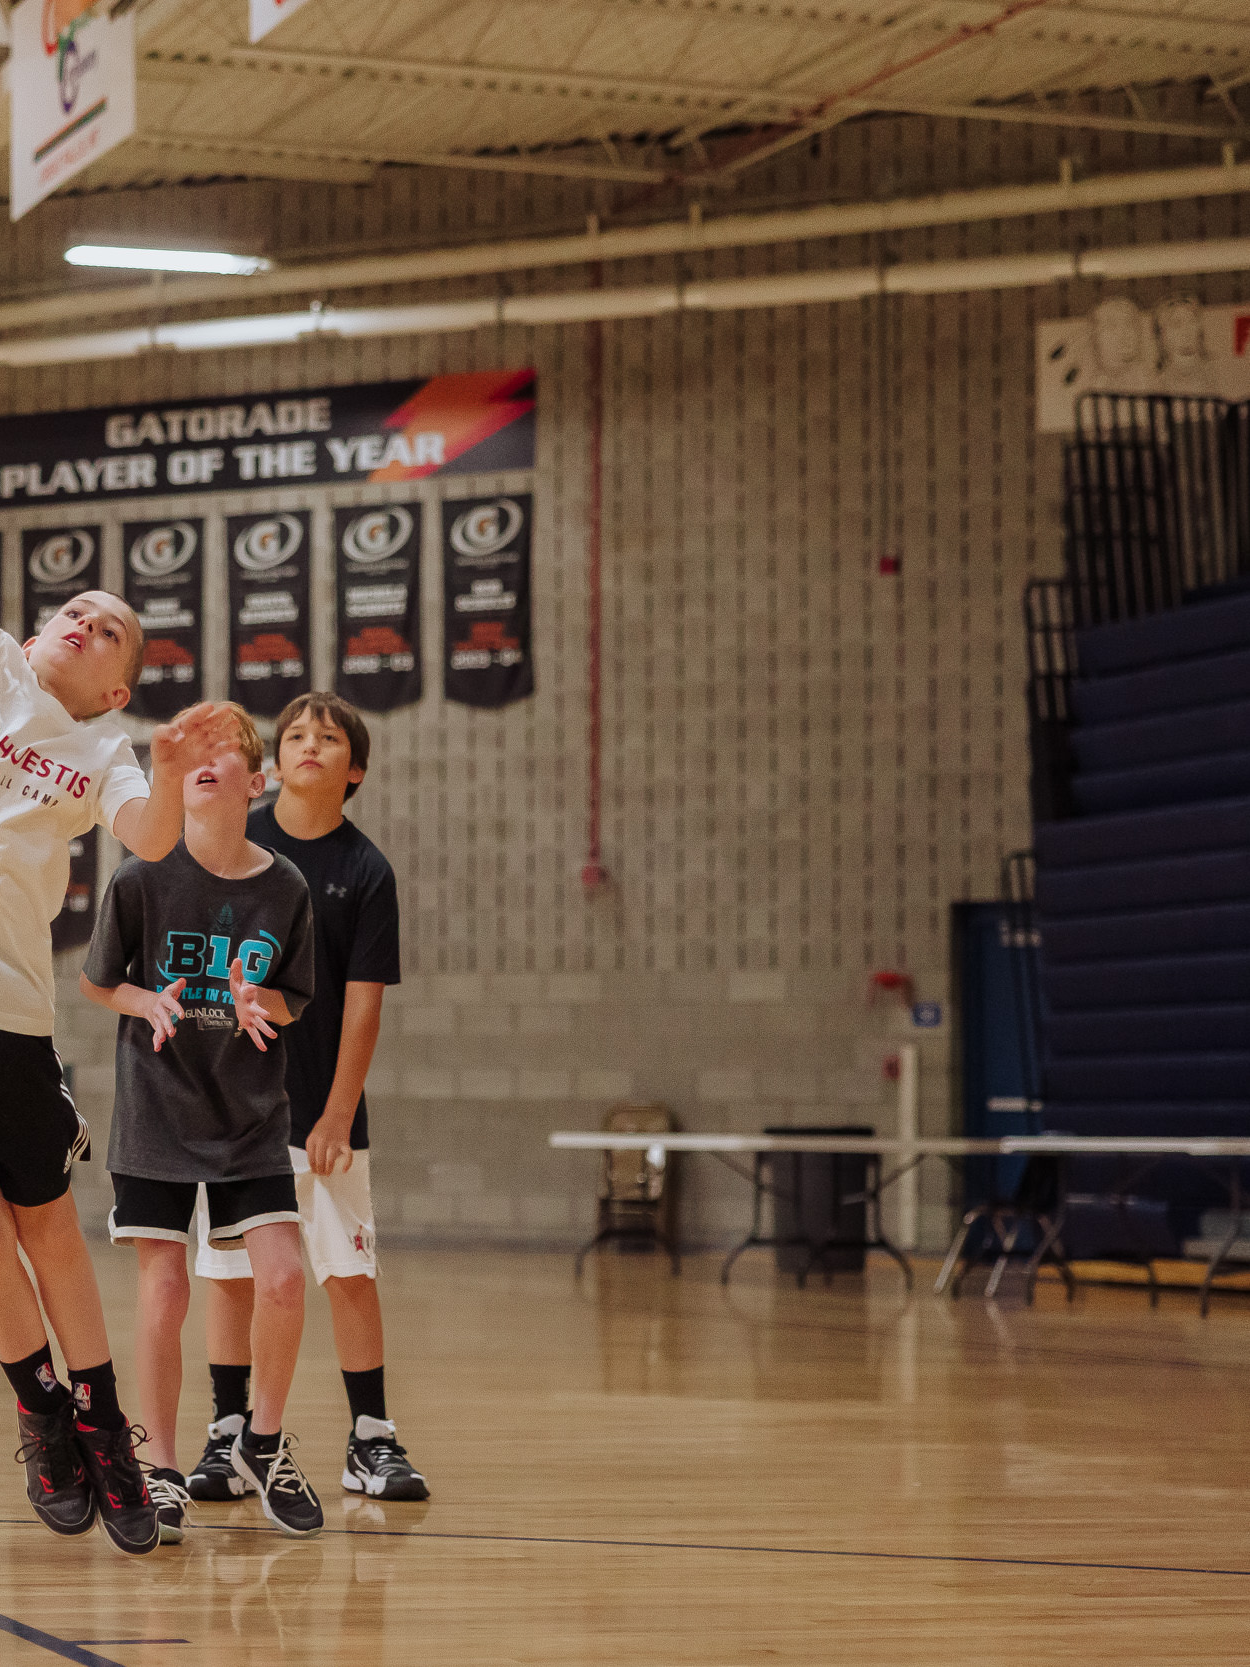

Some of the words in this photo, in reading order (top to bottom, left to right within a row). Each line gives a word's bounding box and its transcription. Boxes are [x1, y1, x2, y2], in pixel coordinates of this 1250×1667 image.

[105, 398, 332, 449] GATORADE
[0, 454, 156, 498] PLAYER
[166, 447, 226, 486] OF
[232, 440, 317, 480] THE
[325, 431, 446, 473] YEAR
[205, 987, 220, 1003] IN
[184, 1007, 227, 1019] GUNLOCK
